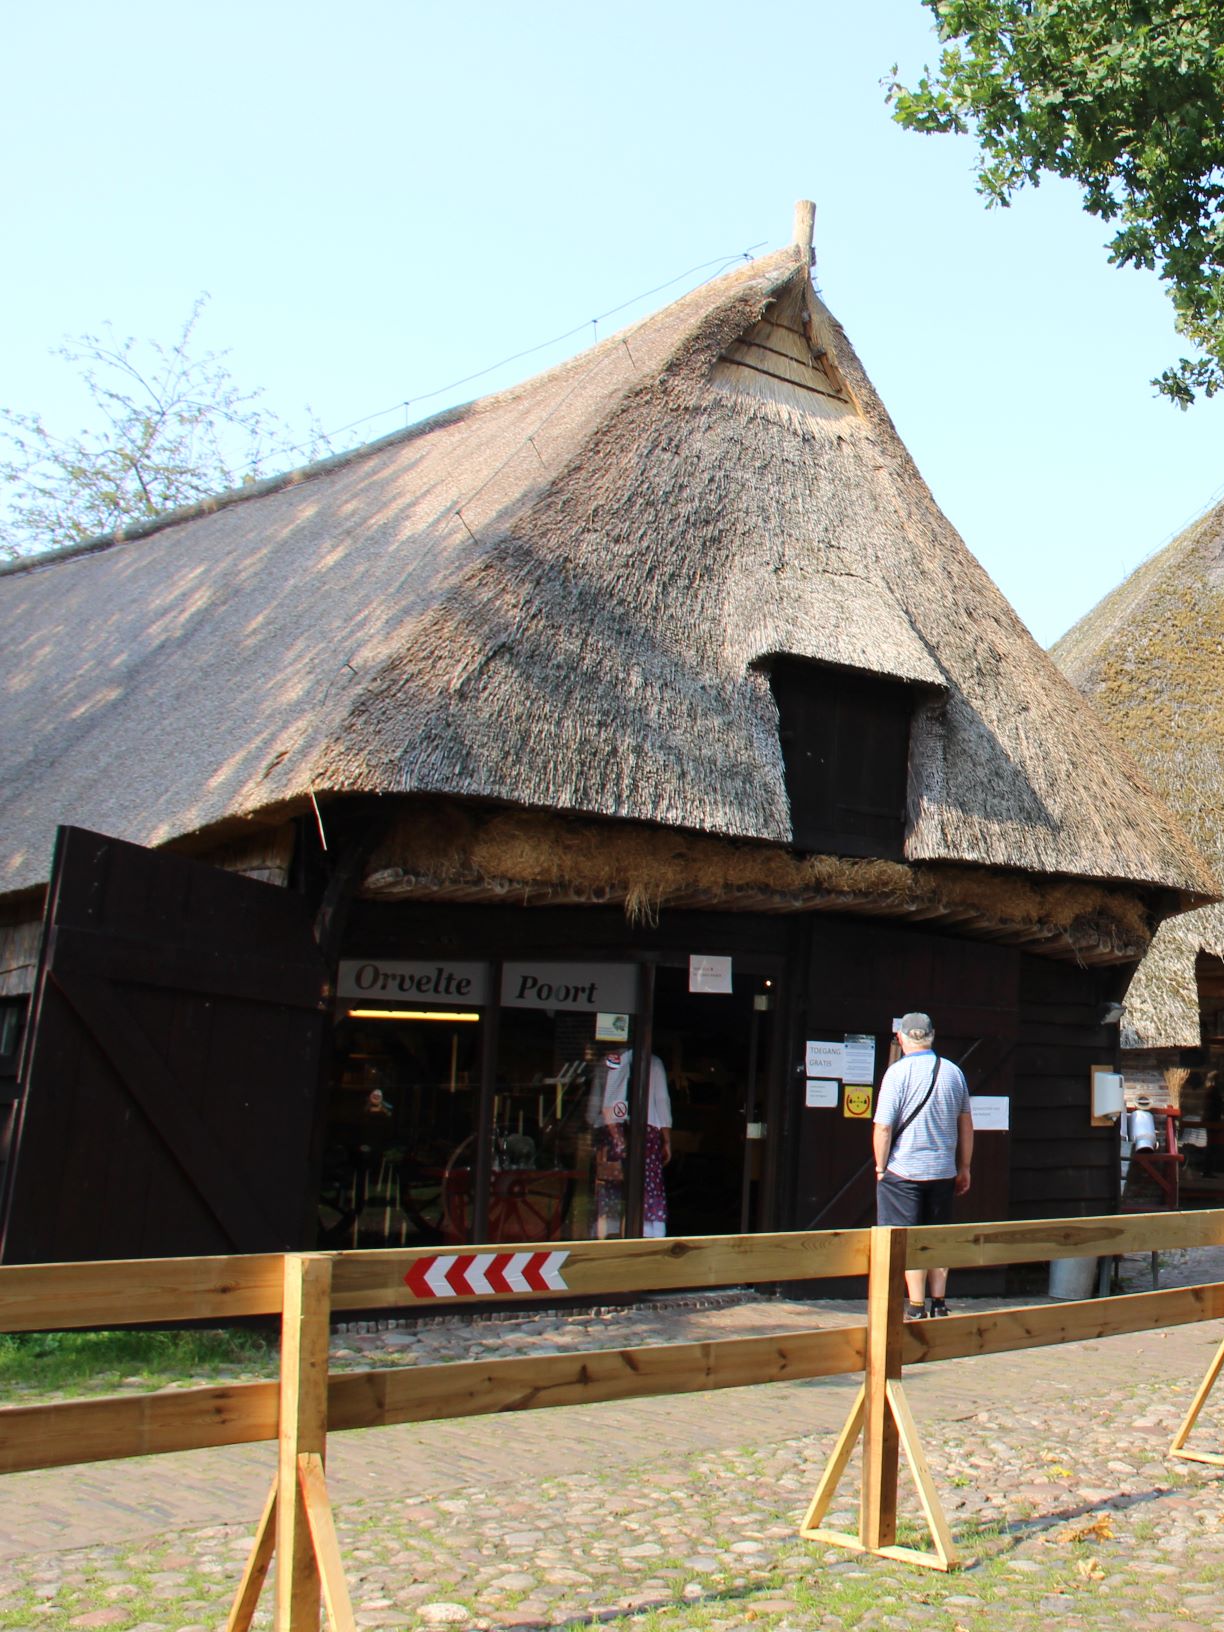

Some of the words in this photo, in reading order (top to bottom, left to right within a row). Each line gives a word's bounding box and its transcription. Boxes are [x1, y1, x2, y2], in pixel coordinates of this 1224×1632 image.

[354, 963, 472, 997] Orvelte
[515, 974, 600, 1004] Poort
[810, 1046, 841, 1056] TOEGANG
[809, 1059, 832, 1067] GRATIS
